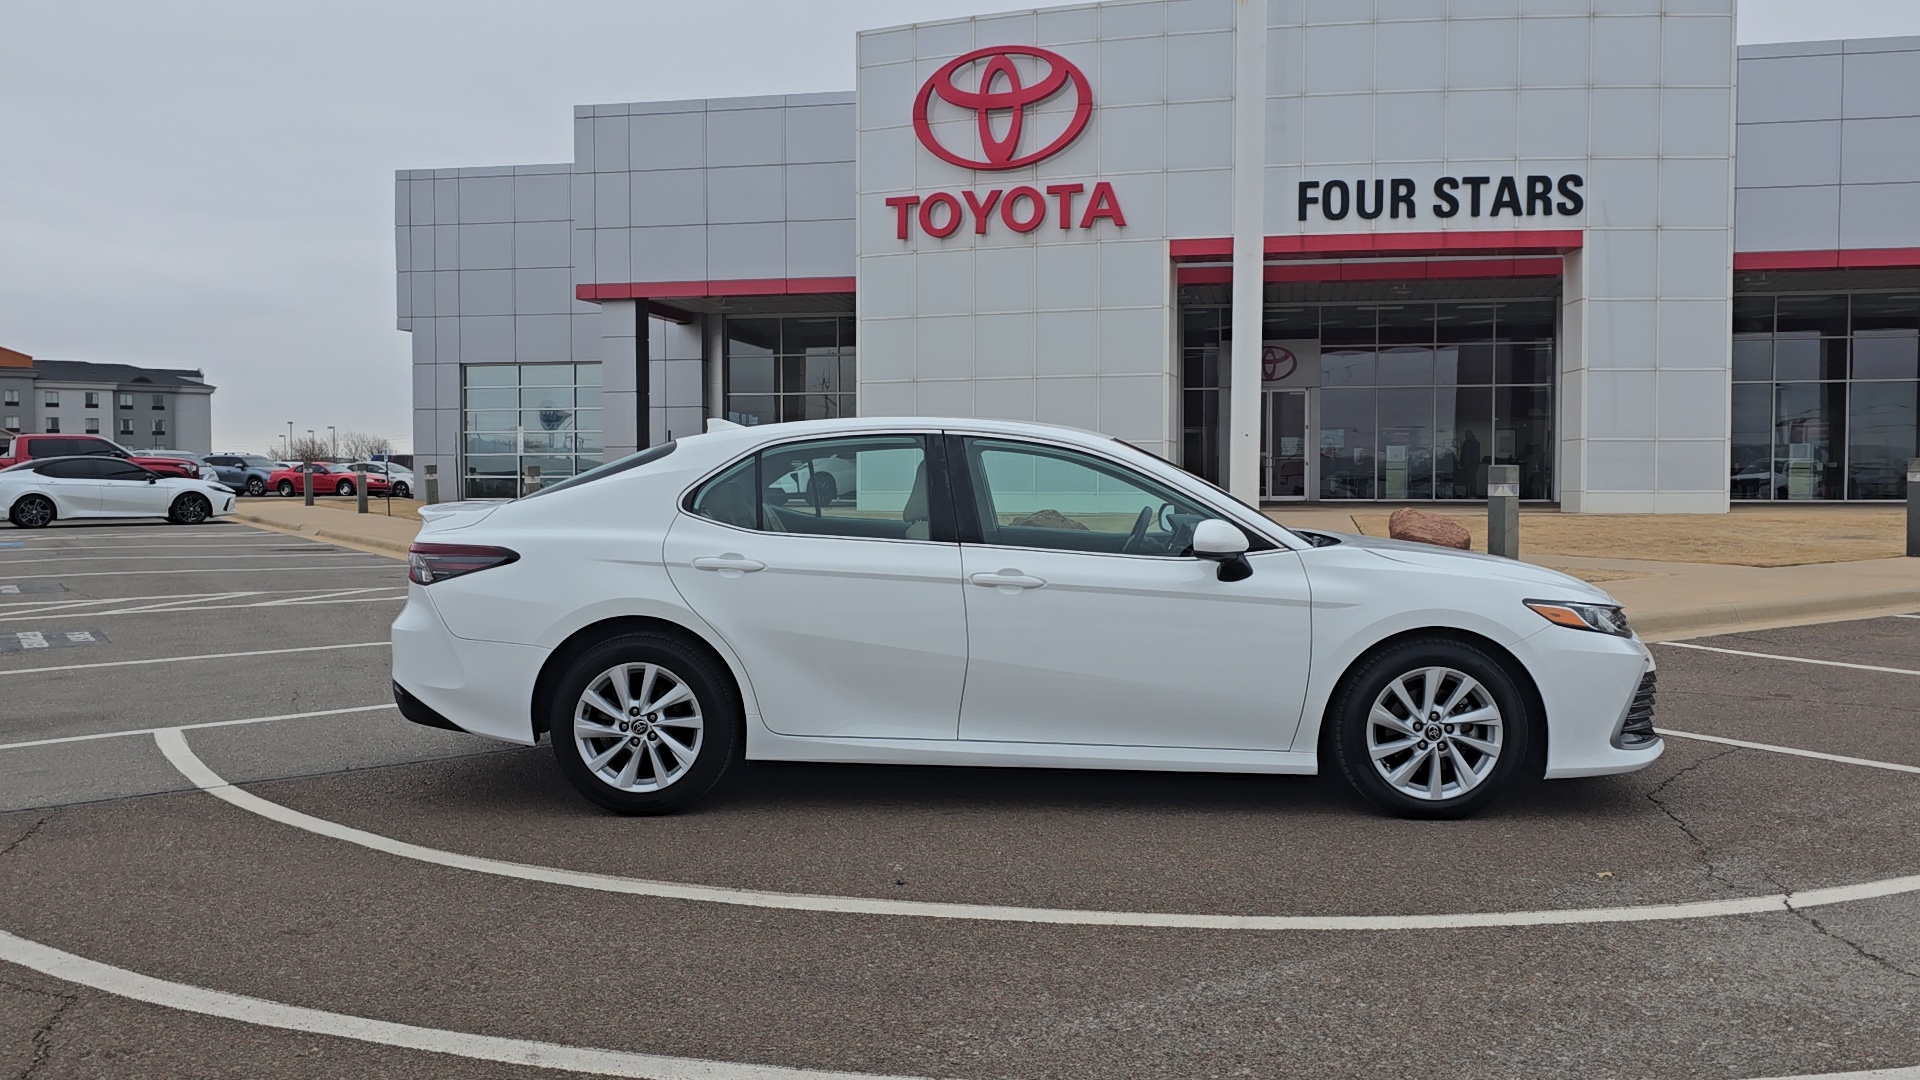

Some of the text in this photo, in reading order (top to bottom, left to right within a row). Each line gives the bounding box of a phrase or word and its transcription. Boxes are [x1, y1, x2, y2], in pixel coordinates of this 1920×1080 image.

[886, 181, 1127, 240] TOYOTA
[1297, 173, 1585, 222] FOUR STARS
